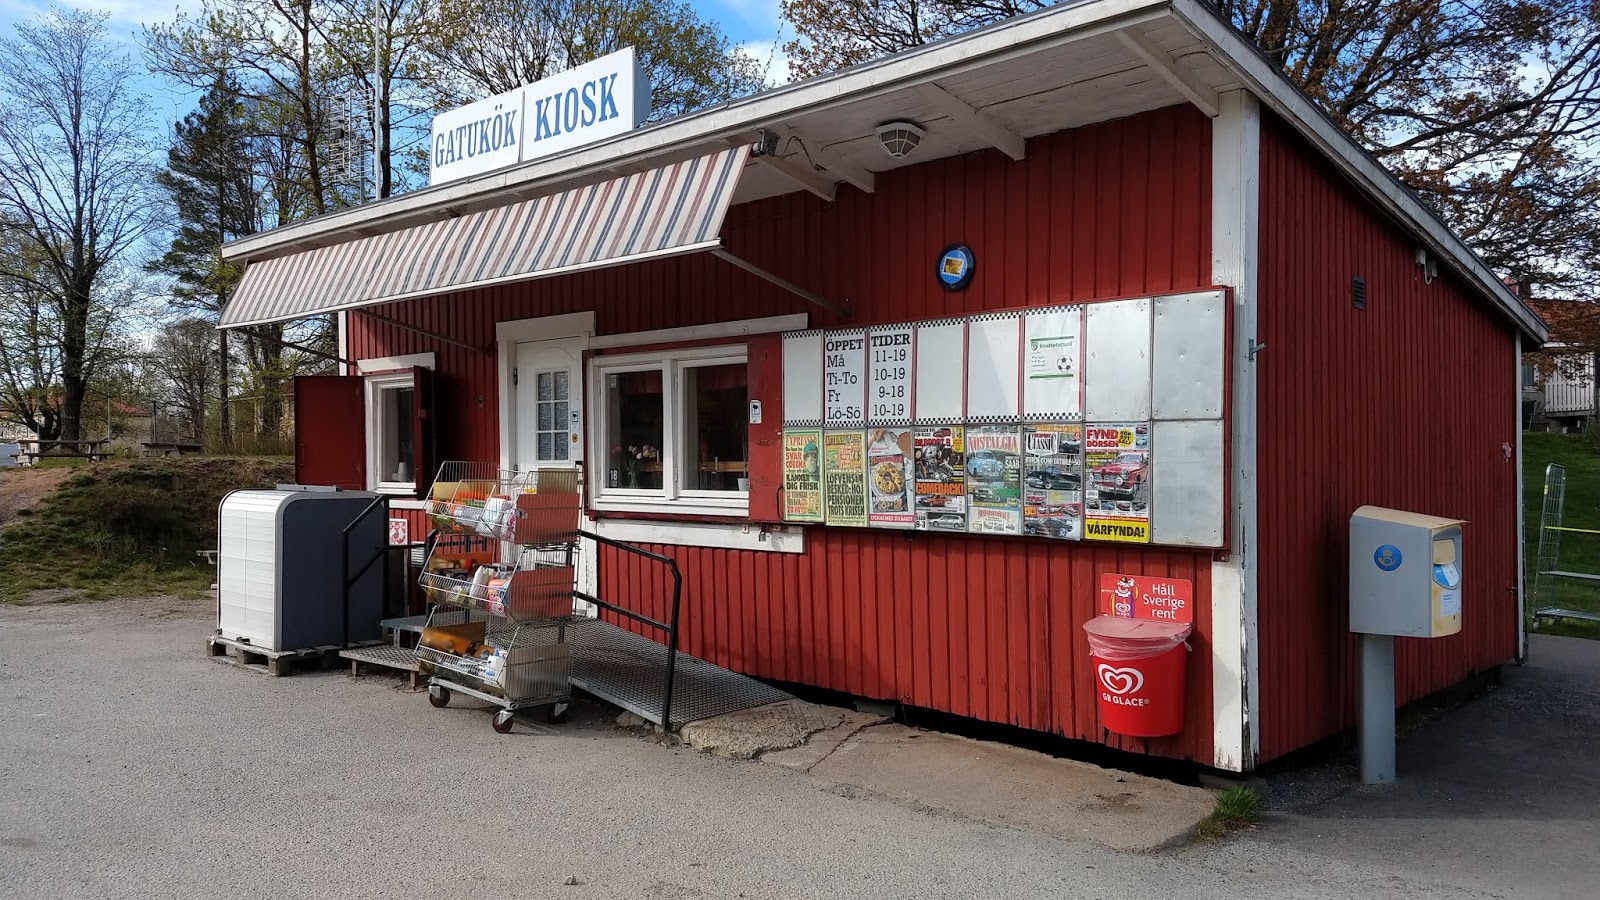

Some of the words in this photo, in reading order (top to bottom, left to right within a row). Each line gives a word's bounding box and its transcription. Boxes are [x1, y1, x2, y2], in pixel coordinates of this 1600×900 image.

[435, 104, 517, 168] GATUKÖK
[534, 72, 619, 142] KIOSK
[826, 338, 863, 352] ÖPPET
[871, 333, 911, 347] TIDER
[827, 354, 845, 368] Må
[875, 349, 906, 363] 11-19
[827, 371, 857, 385] Ti-To
[874, 367, 906, 381] 10-19
[828, 390, 841, 402] Fr
[878, 385, 905, 398] 9-18
[828, 406, 861, 420] Lö-Sö
[874, 403, 905, 417] 10-19
[1087, 429, 1118, 439] FYND
[968, 436, 1018, 451] NOSTALGIA
[1087, 438, 1118, 447] BÖRSEN
[1005, 459, 1020, 469] SAAB
[610, 469, 618, 481] 18
[786, 482, 798, 490] DIG
[800, 482, 819, 490] FRISK
[916, 482, 964, 495] COMEBACK!
[828, 494, 864, 505] PENSIONEN
[1087, 521, 1144, 538] VÅRFYNDA!
[1152, 582, 1175, 596] Håll
[1143, 593, 1185, 610] Sverige
[1152, 608, 1176, 619] rent
[1102, 692, 1111, 702] GB
